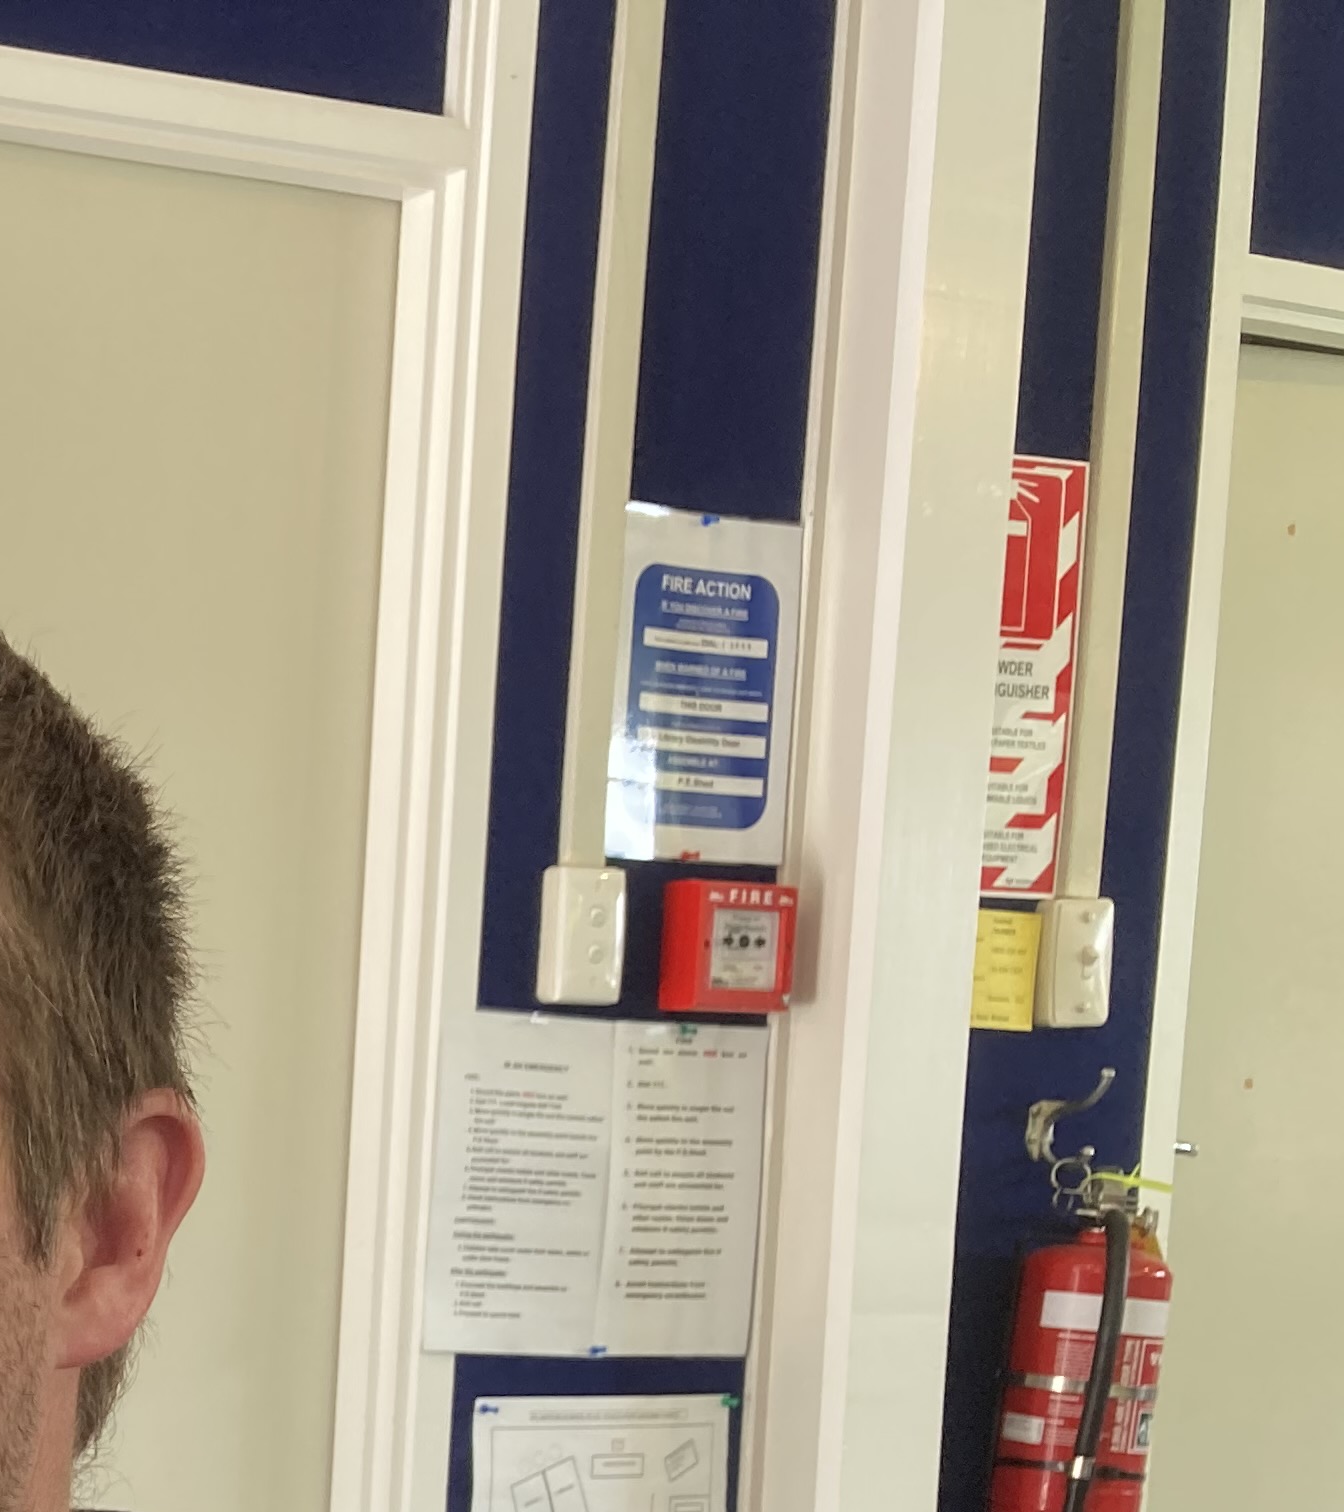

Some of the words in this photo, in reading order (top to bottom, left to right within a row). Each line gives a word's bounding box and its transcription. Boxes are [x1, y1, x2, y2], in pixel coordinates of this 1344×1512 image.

[662, 574, 693, 594] FIRE
[696, 579, 752, 600] ACTION
[729, 889, 774, 905] FIRE
